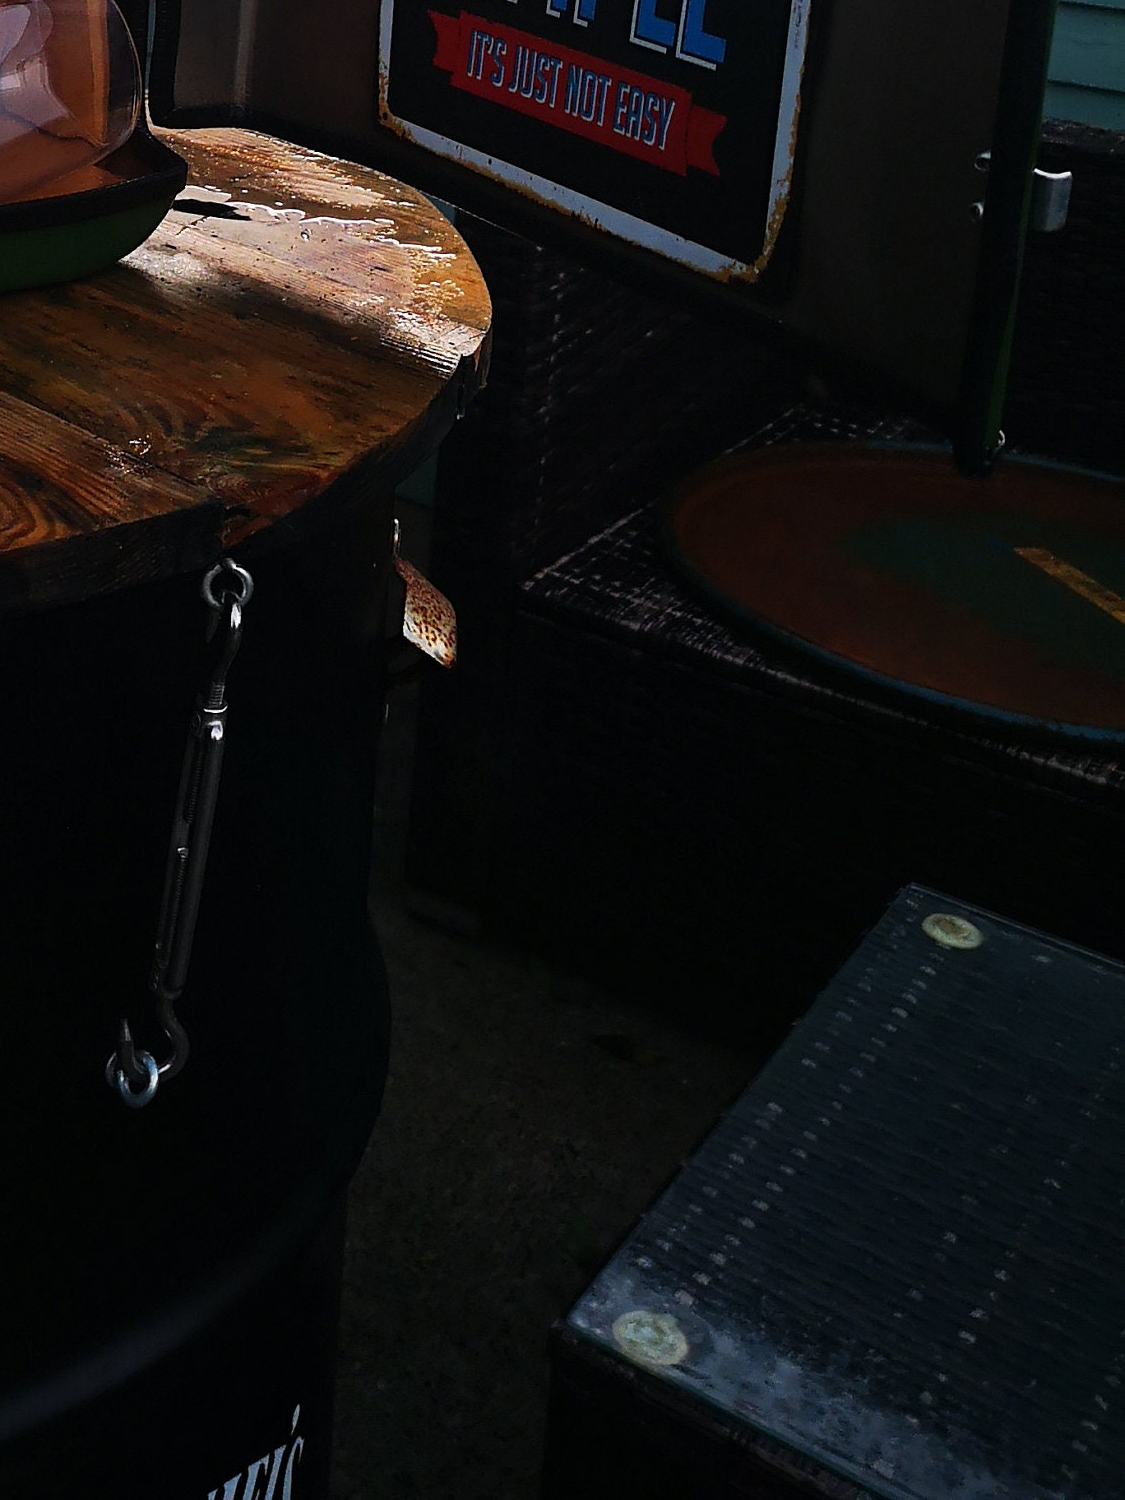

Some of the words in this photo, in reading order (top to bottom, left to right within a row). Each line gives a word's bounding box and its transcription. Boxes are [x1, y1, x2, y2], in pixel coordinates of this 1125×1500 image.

[467, 29, 508, 88] IT'S
[508, 45, 564, 109] JUST
[564, 63, 613, 127] NOT
[613, 81, 677, 152] EASY
